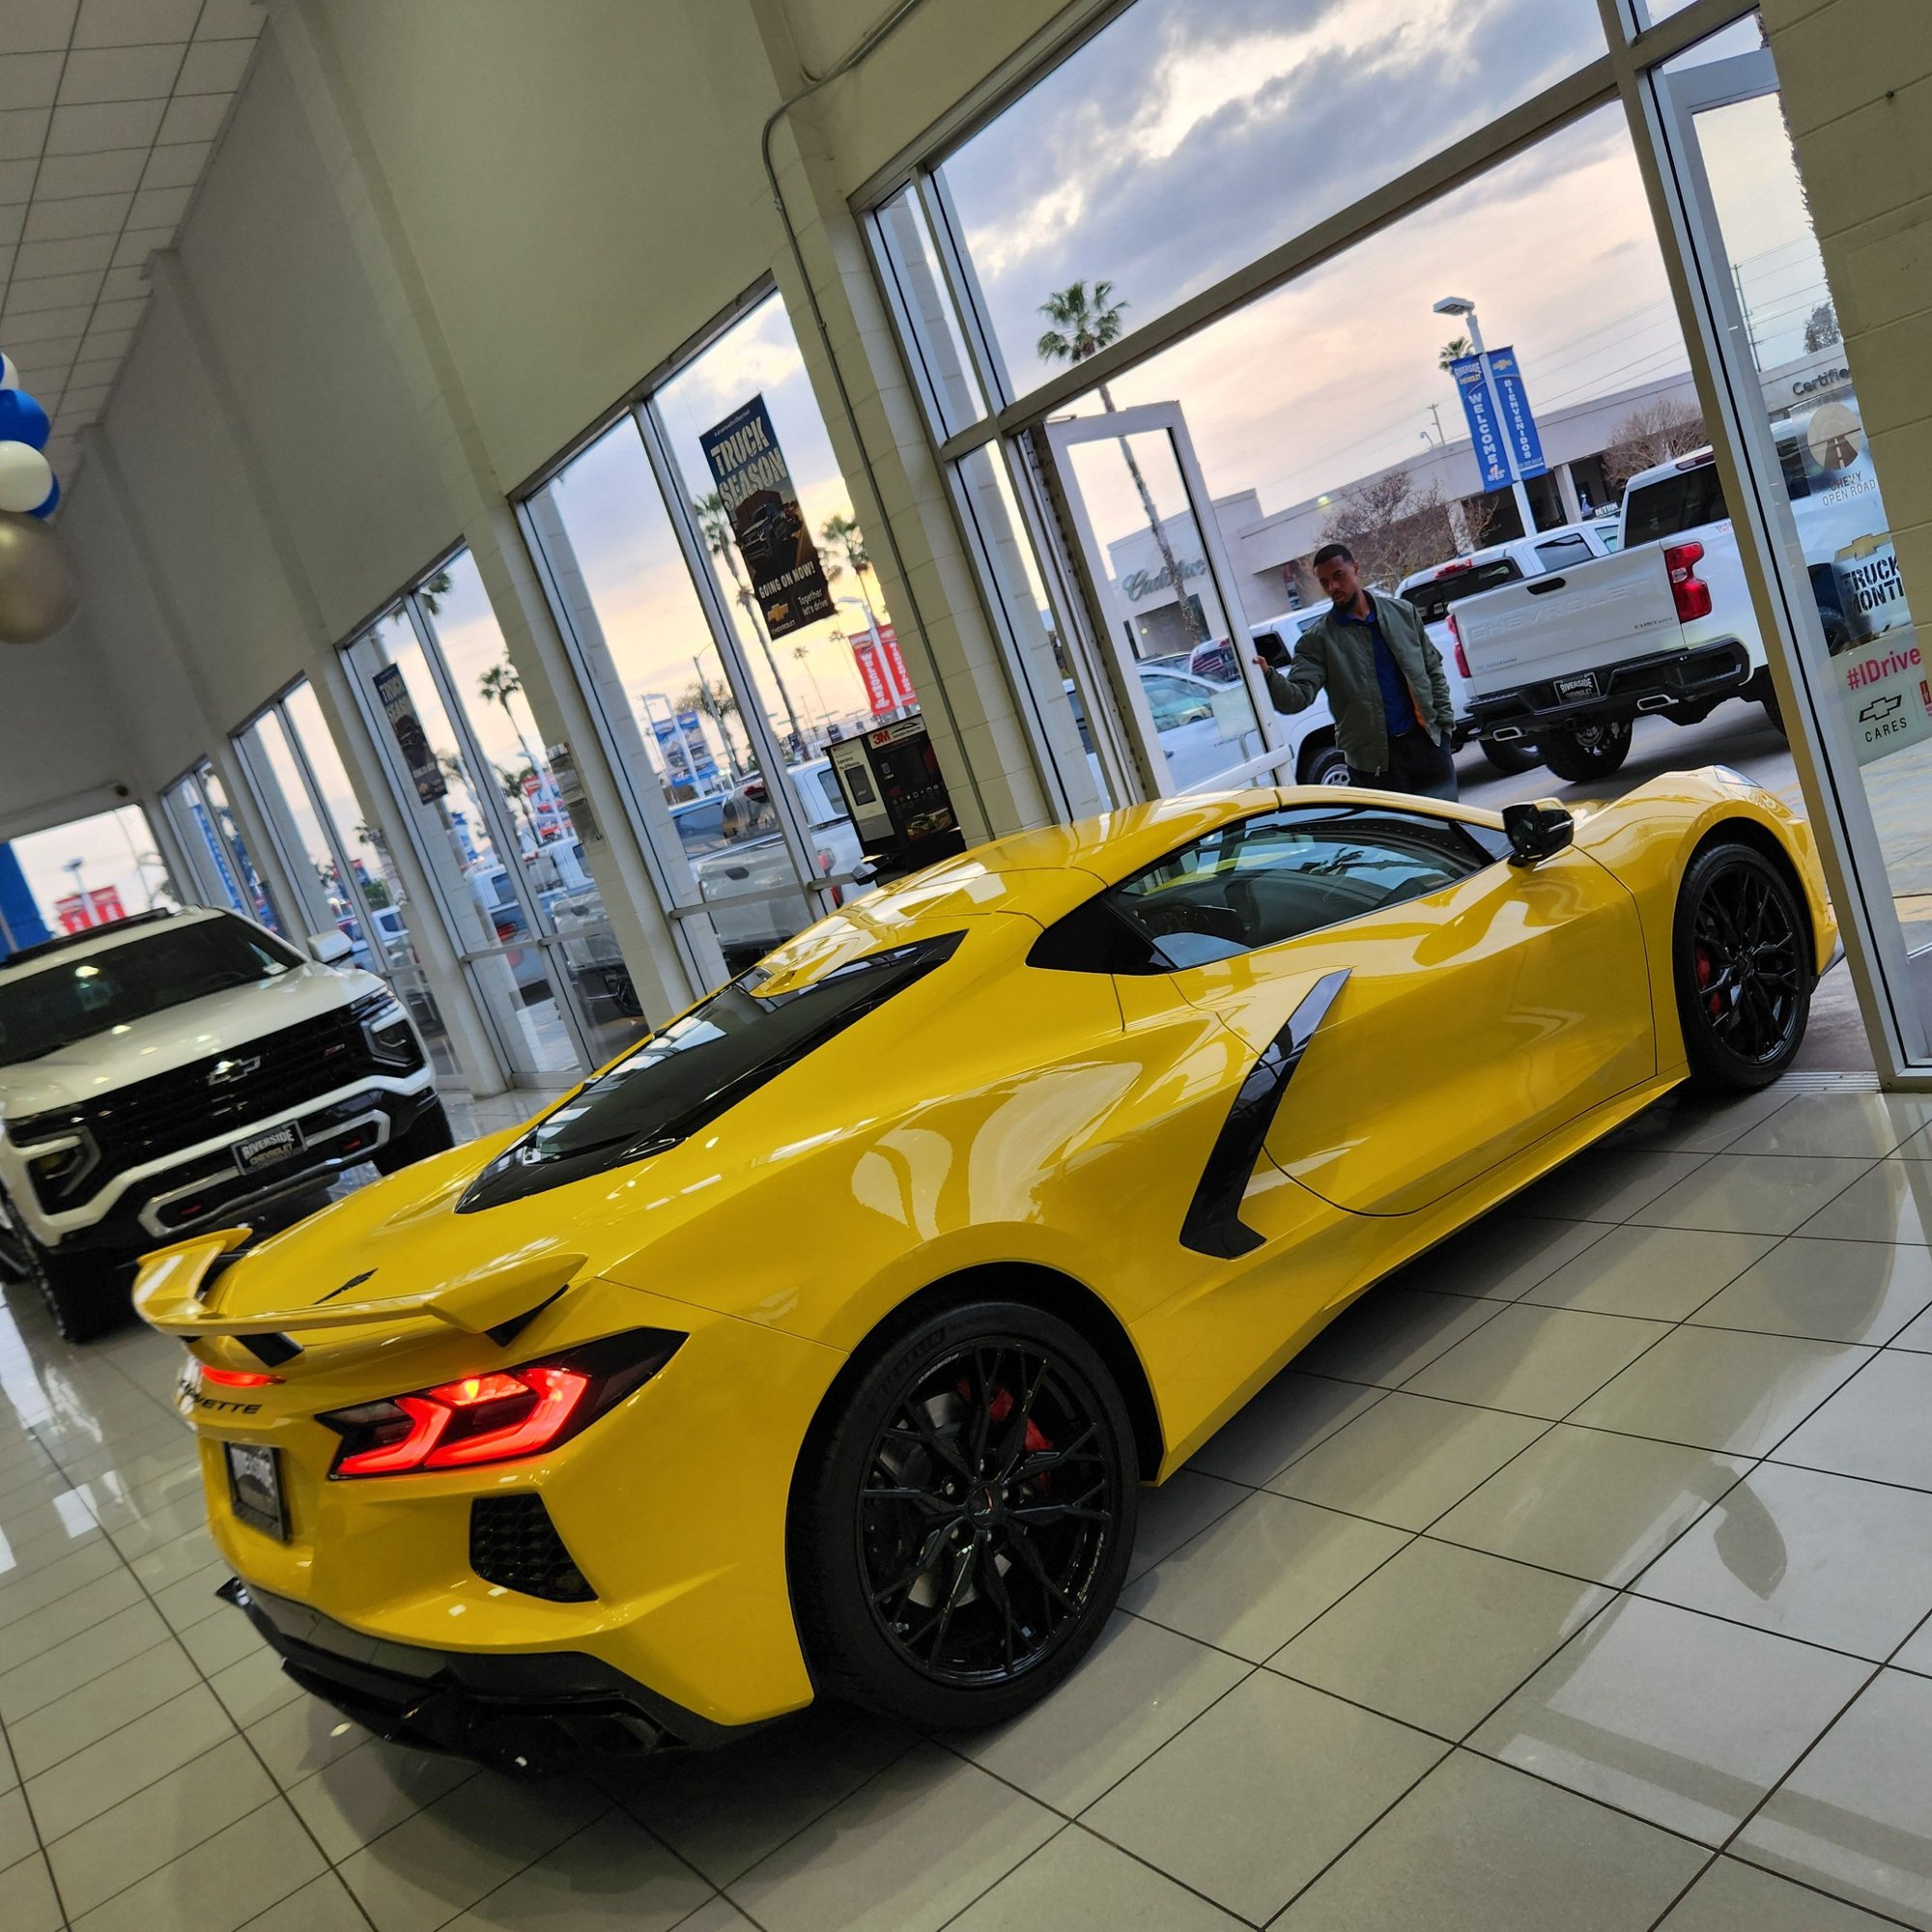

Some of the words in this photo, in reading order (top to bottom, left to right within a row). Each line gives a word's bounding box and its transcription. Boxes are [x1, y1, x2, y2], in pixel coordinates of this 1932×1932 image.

[1468, 392, 1498, 465] WELCOME
[1504, 379, 1532, 460] BIENVENIDOS
[710, 416, 770, 477] TRUCK
[719, 447, 788, 511] SEASON
[1822, 488, 1849, 507] OPEN
[1852, 478, 1877, 497] ROAD
[758, 578, 782, 599] GOING
[781, 573, 794, 588] ON
[792, 560, 816, 582] NOW!
[1840, 555, 1900, 591] TRUCK
[797, 588, 823, 606] Together
[813, 599, 829, 612] drive
[1559, 676, 1594, 694] RIVERSIDE
[1846, 647, 1922, 690] #IDrive
[872, 729, 892, 745] 3M
[1864, 717, 1907, 742] CARES
[242, 1128, 296, 1159] RIVERSIDE
